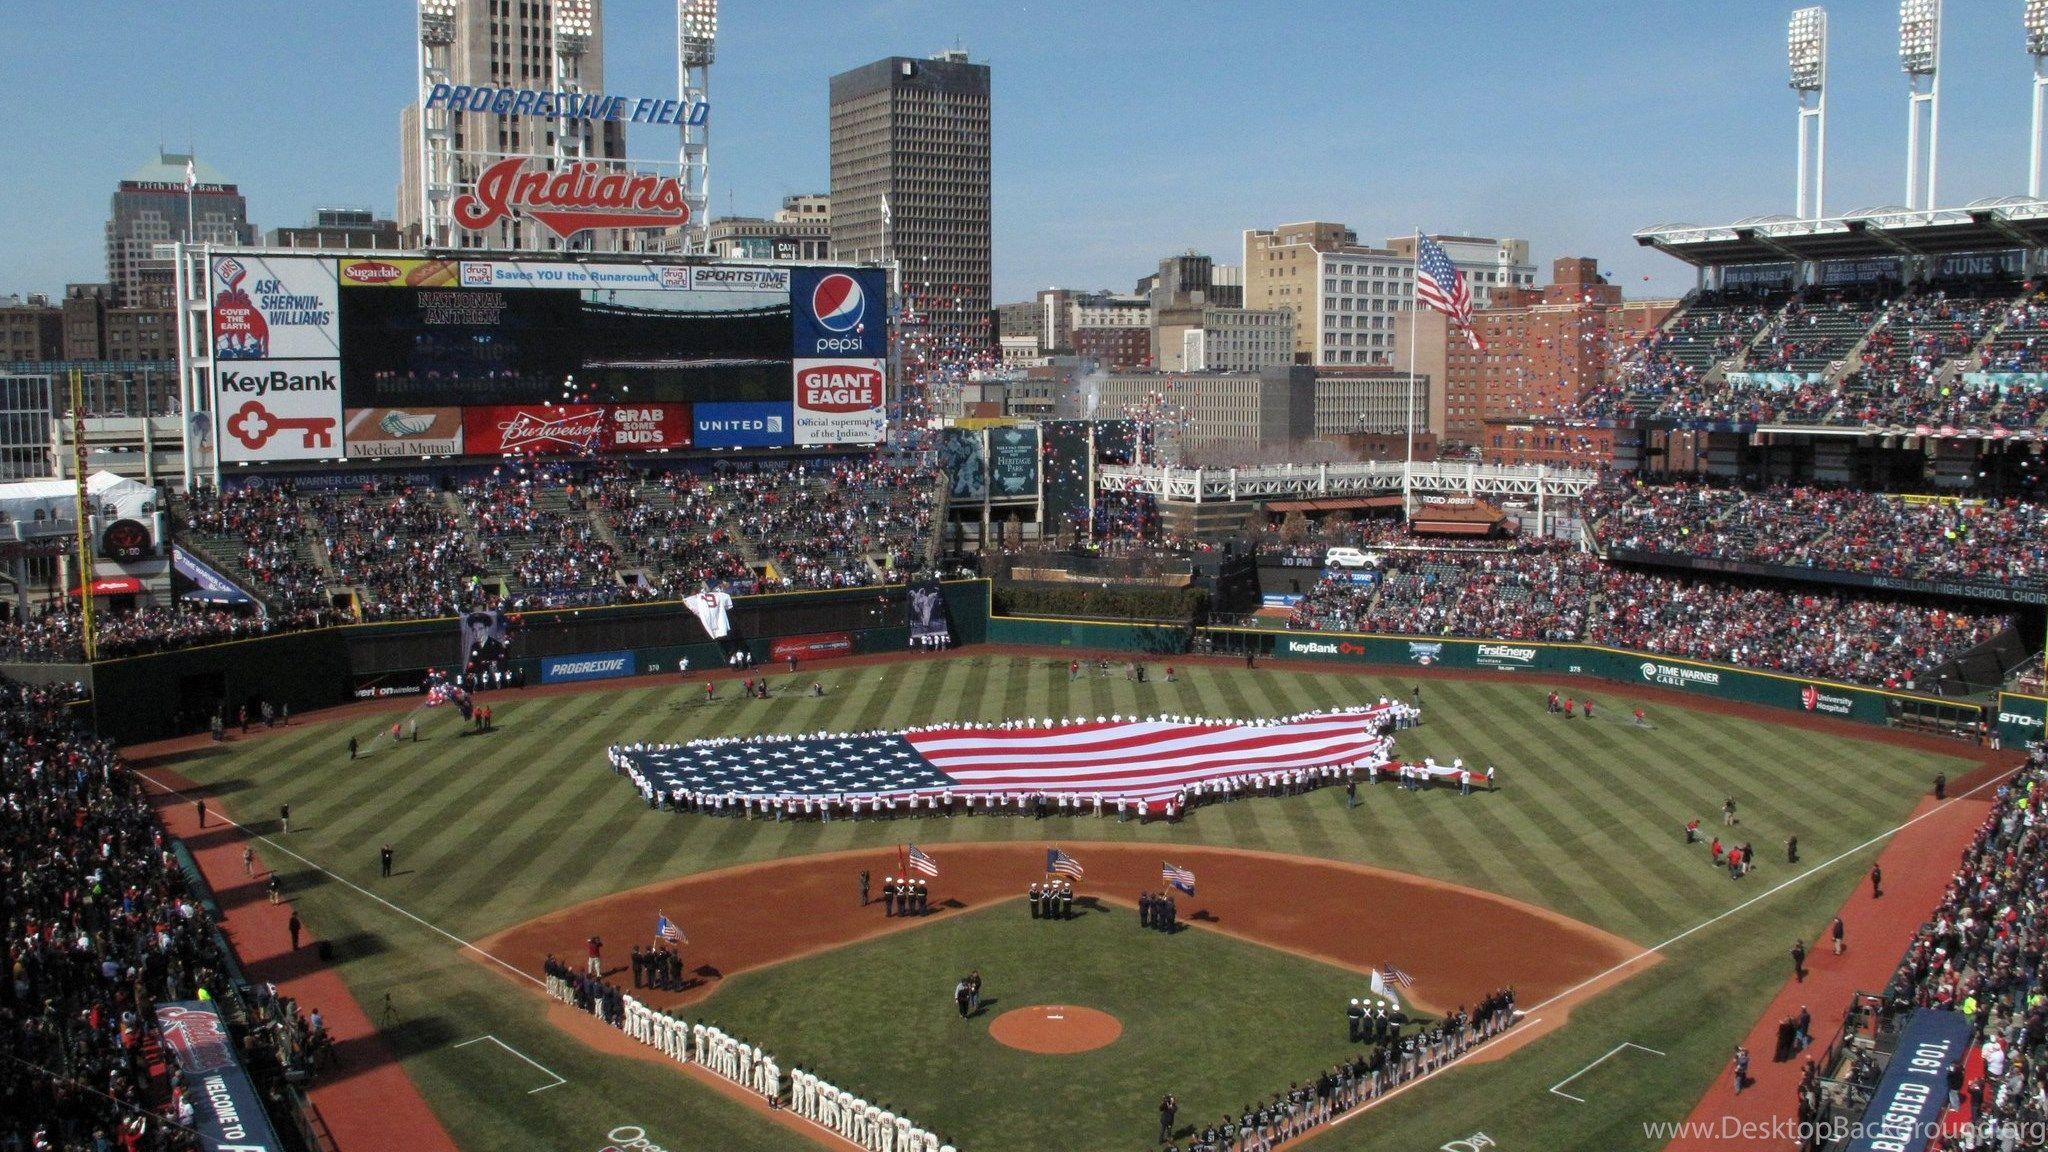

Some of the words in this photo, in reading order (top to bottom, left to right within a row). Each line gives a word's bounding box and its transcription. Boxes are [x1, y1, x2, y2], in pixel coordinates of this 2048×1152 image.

[425, 84, 628, 121] PROGRESSIVE
[631, 98, 711, 126] FIELD
[453, 157, 690, 238] Indians
[466, 264, 487, 275] drug
[664, 265, 684, 280] drug
[1943, 257, 1994, 275] JUNE
[345, 266, 400, 281] Sugardale
[468, 274, 493, 283] mart
[496, 270, 533, 281] Saves
[537, 271, 562, 281] YOU
[567, 272, 587, 281] the
[695, 270, 789, 284] SPORTSTIME
[255, 280, 281, 294] ASK
[665, 278, 688, 287] mart
[759, 282, 783, 290] OHIO
[261, 296, 324, 310] SHERWIN-
[418, 291, 507, 308] NATIONAL
[220, 308, 250, 316] COVER
[270, 311, 330, 326] WILLIAMS
[425, 309, 501, 325] ANTHEM
[816, 336, 863, 354] pepsi
[222, 371, 337, 396] KeyBank
[805, 373, 873, 388] GIANT
[807, 390, 872, 404] EAGLE
[615, 410, 664, 422] GRAB
[498, 419, 601, 440] Budweiser
[624, 422, 656, 431] SOME
[700, 420, 763, 431] UNITED
[616, 430, 664, 443] BUDS
[811, 430, 820, 438] of
[821, 430, 833, 438] the
[354, 443, 405, 456] Medical
[409, 441, 455, 454] Mutual
[295, 475, 342, 486] WARNER
[1296, 558, 1312, 567] PM
[1936, 583, 1962, 595] HIGH
[1964, 586, 2009, 600] SCHOOL
[2012, 590, 2048, 604] CHOIR
[1289, 641, 1338, 654] KeyBank
[1477, 645, 1536, 659] FirstEnergy
[550, 659, 627, 675] PROGRESSIVE
[1657, 664, 1679, 677] TIME
[1680, 668, 1719, 683] WARNER
[1656, 675, 1686, 687] CABLE
[1817, 693, 1853, 707] University
[1816, 702, 1850, 713] Hospitals
[1907, 1039, 1951, 1076] 1901.
[203, 1075, 239, 1124] WELCOME
[222, 1126, 246, 1140] TO
